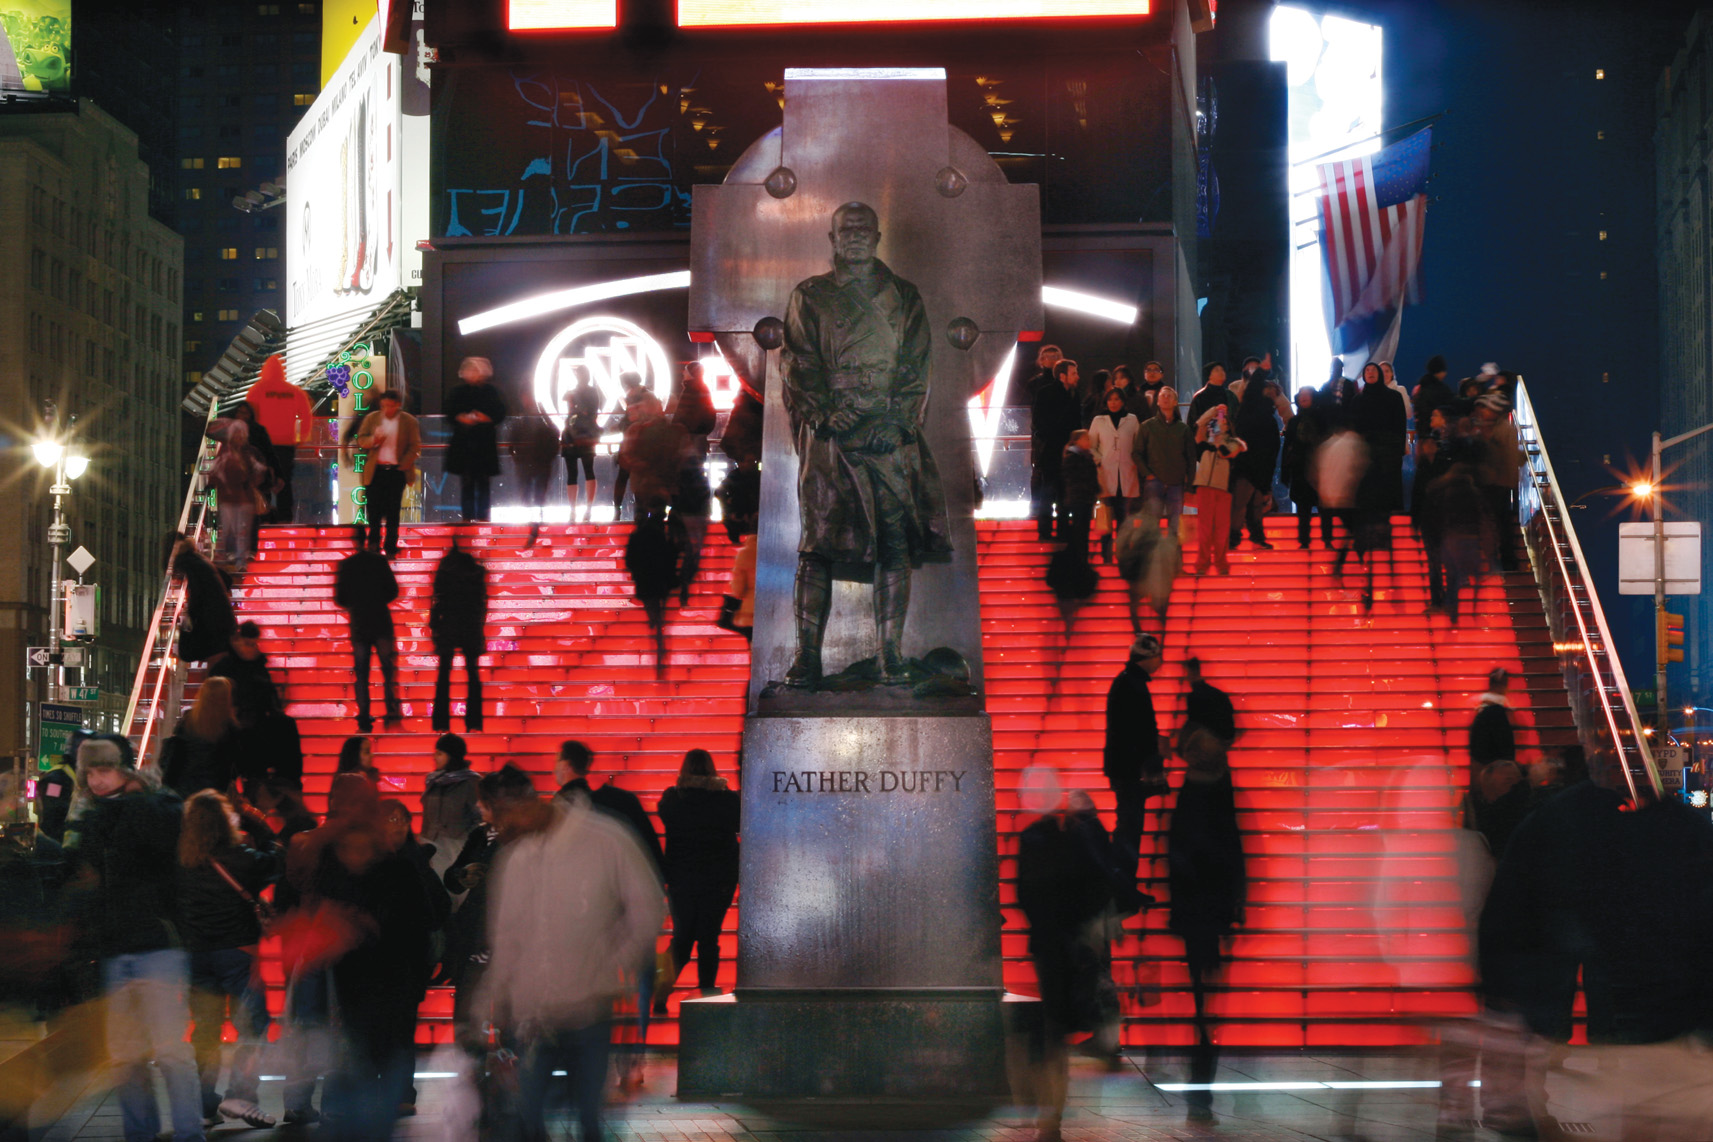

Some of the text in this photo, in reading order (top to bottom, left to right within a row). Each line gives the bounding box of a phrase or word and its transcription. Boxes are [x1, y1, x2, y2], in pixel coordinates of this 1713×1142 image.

[71, 688, 78, 699] W
[79, 688, 88, 699] 47
[42, 709, 55, 720] TIMES
[63, 711, 82, 722] SHUFFLE
[42, 728, 49, 738] TO
[771, 770, 968, 793] FATHER DUFFY
